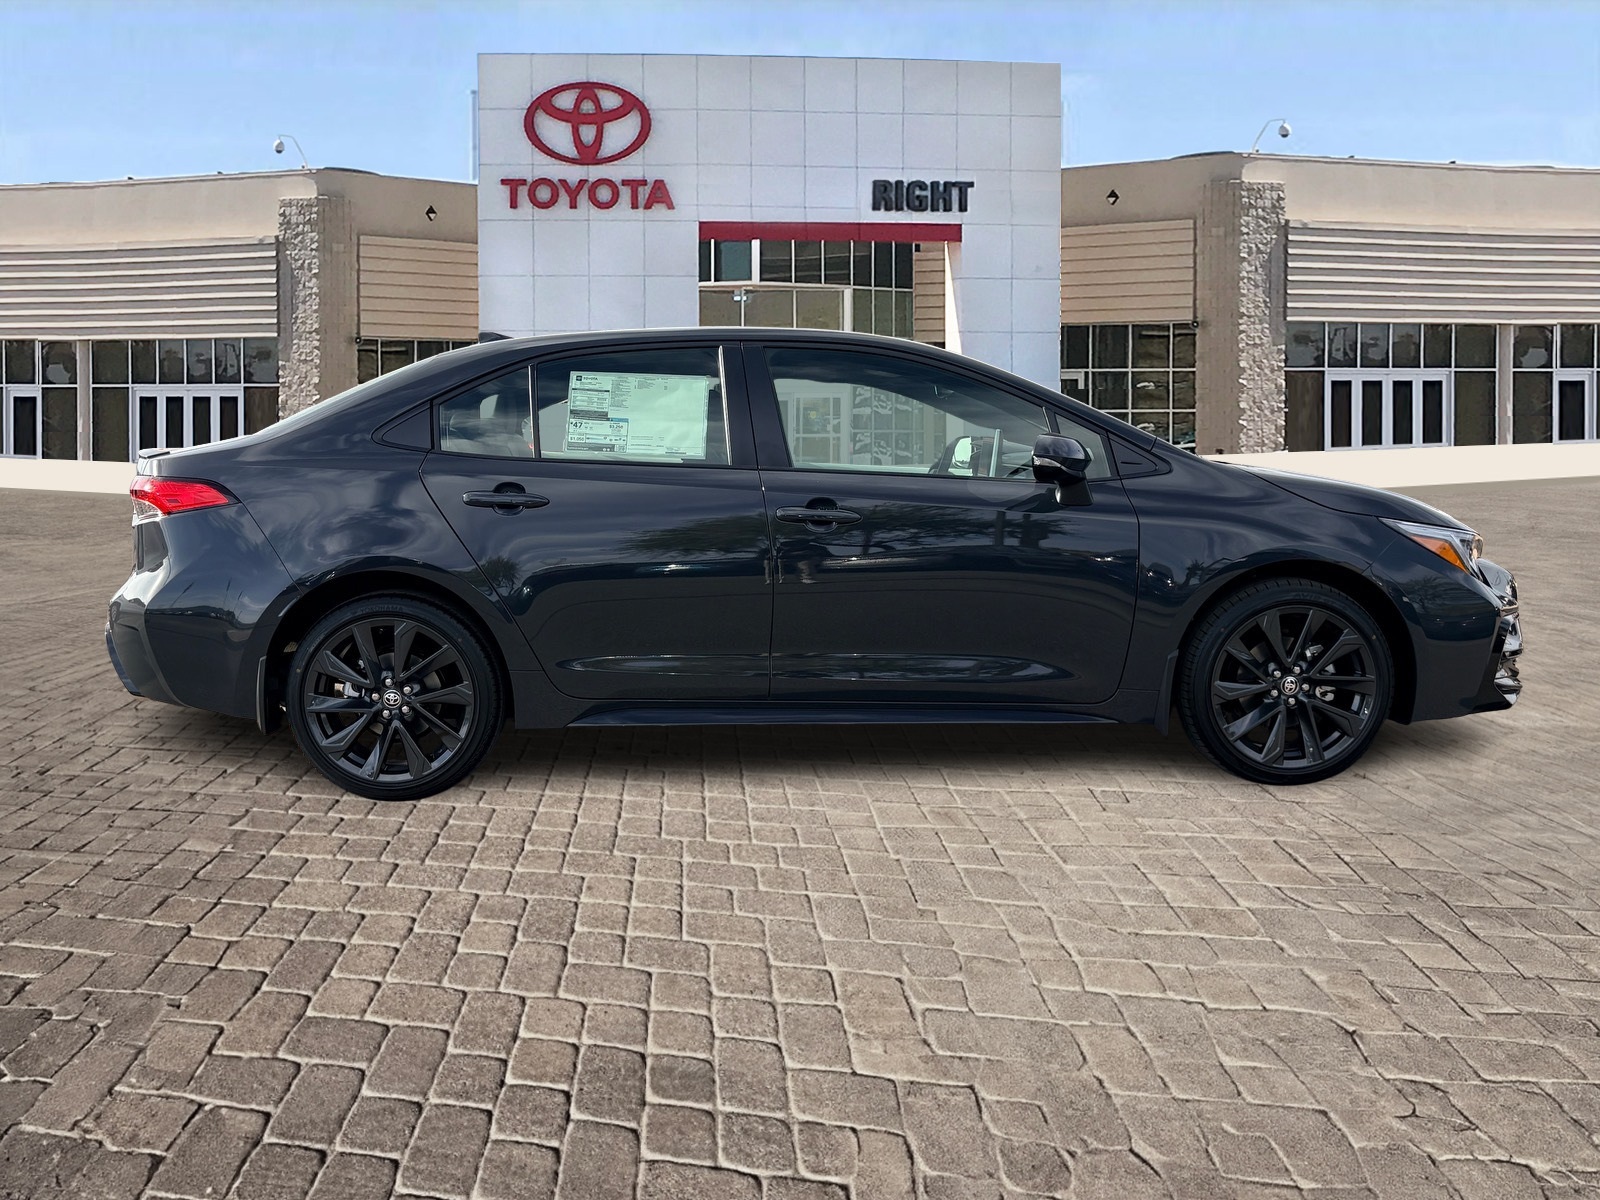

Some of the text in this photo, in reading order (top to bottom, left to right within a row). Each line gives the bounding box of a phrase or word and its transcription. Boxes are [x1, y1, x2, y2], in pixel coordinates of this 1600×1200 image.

[501, 178, 674, 210] TOYOTA
[872, 180, 974, 212] RIGHT
[573, 421, 583, 429] 47
[360, 605, 403, 613] YOKOHAMA
